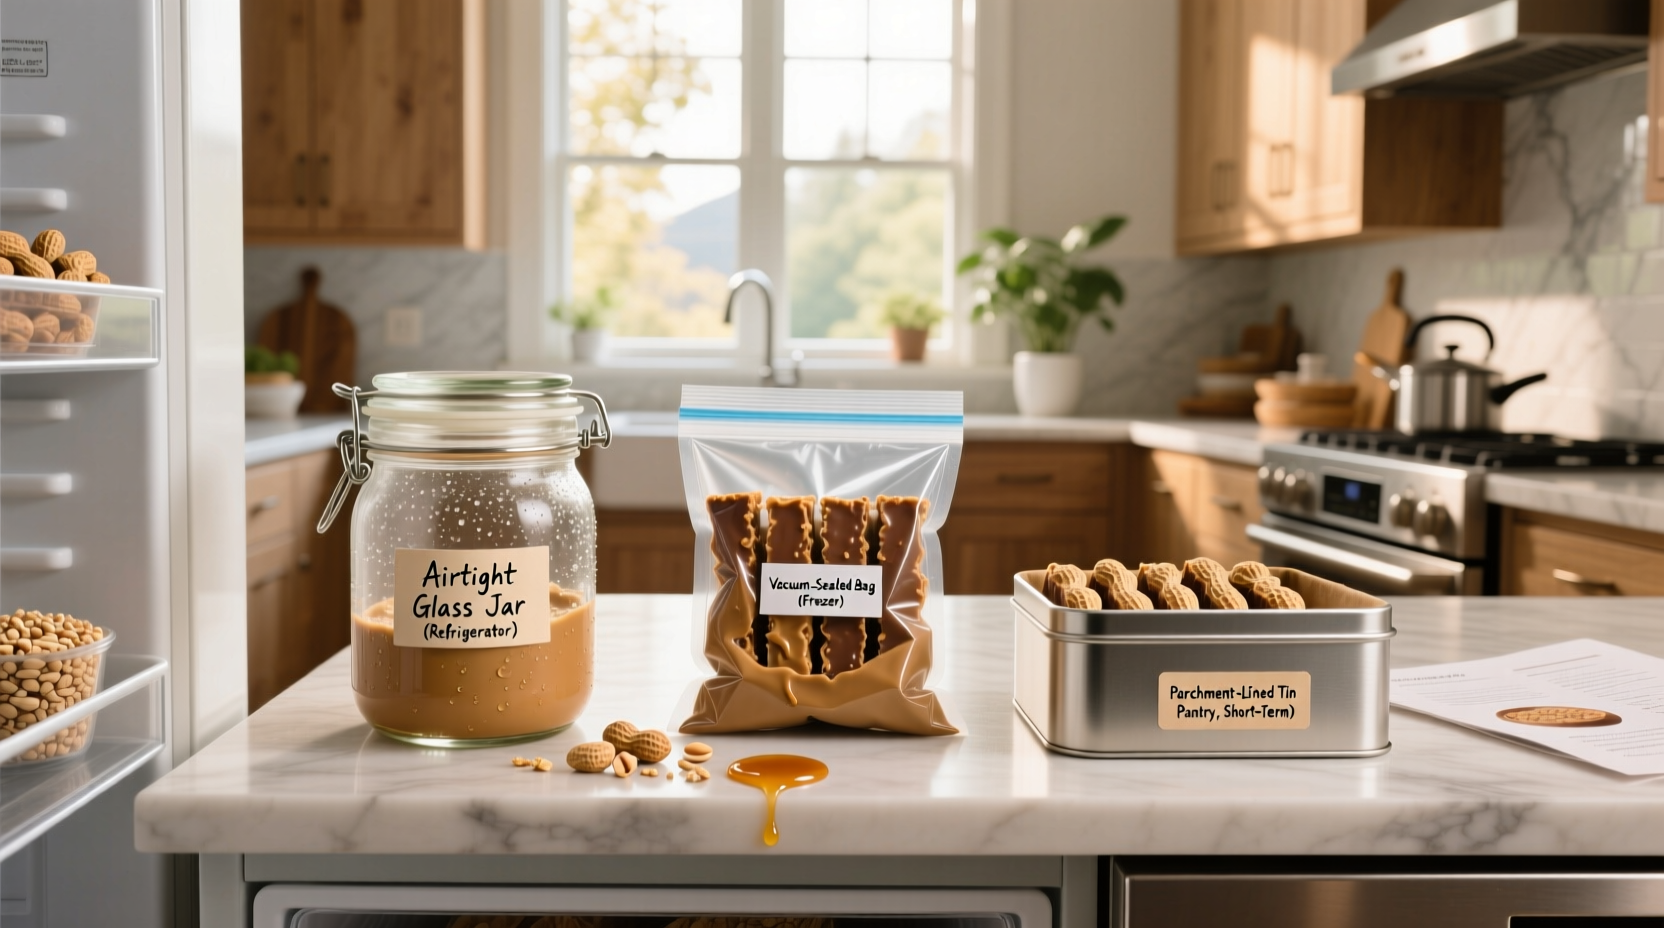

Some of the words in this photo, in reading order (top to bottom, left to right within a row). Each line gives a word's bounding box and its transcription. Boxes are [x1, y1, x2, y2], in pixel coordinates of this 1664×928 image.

[422, 560, 517, 595] Airtight
[854, 578, 876, 595] Bag
[412, 593, 473, 618] Glass
[485, 593, 526, 617] Jar
[423, 621, 518, 642] (Refrigerator)
[1170, 685, 1275, 700] Parchment-Lined
[1177, 704, 1220, 722] Pantry,
[1223, 704, 1295, 719] Short-Term)
